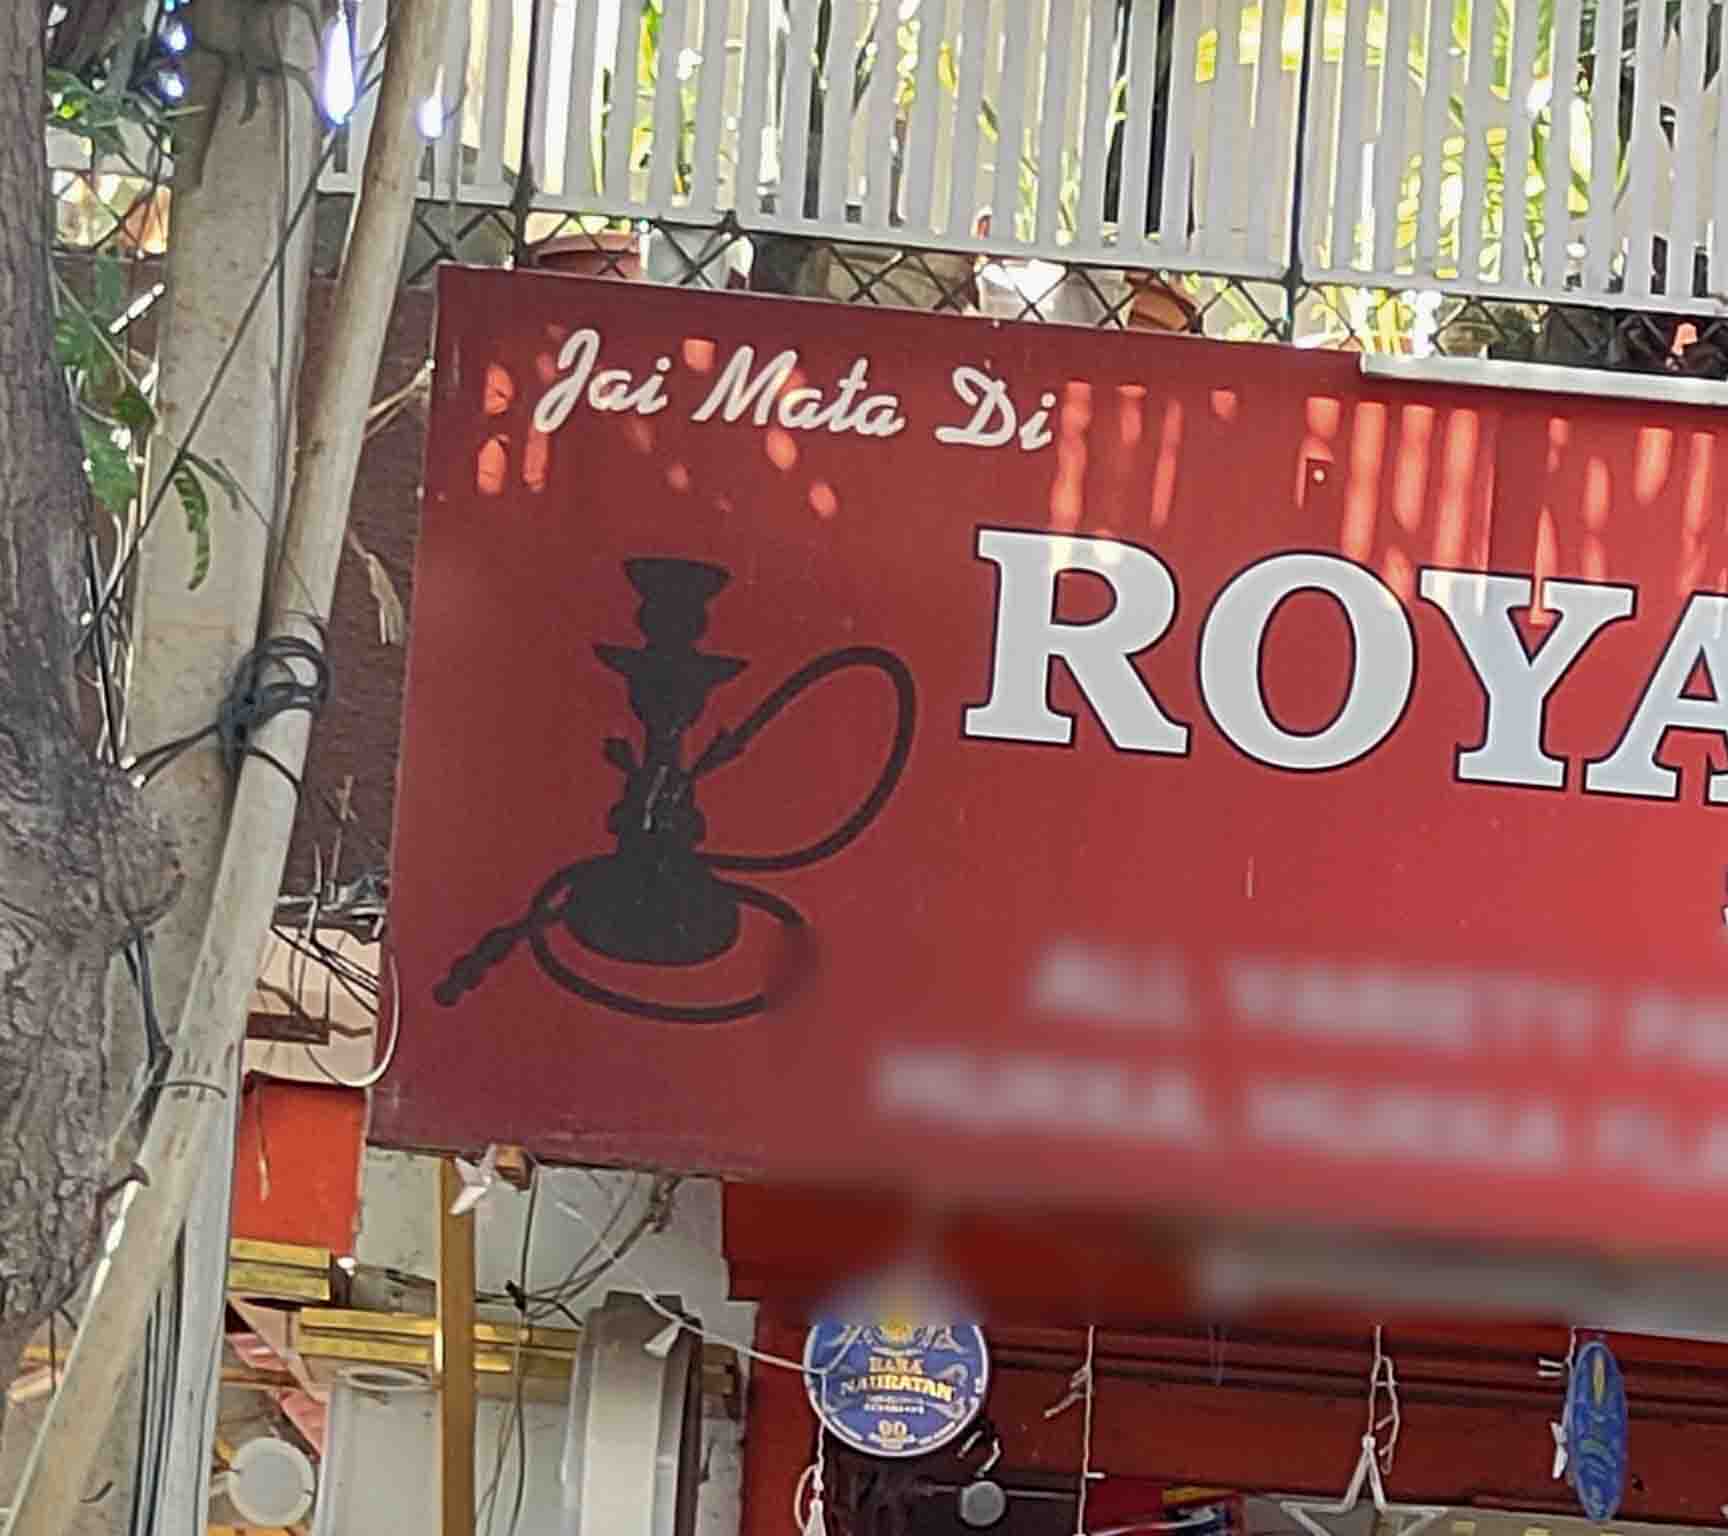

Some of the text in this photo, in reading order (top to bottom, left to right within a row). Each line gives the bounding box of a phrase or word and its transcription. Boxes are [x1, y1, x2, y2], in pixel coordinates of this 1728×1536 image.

[533, 327, 1058, 453] Jai Mata Di
